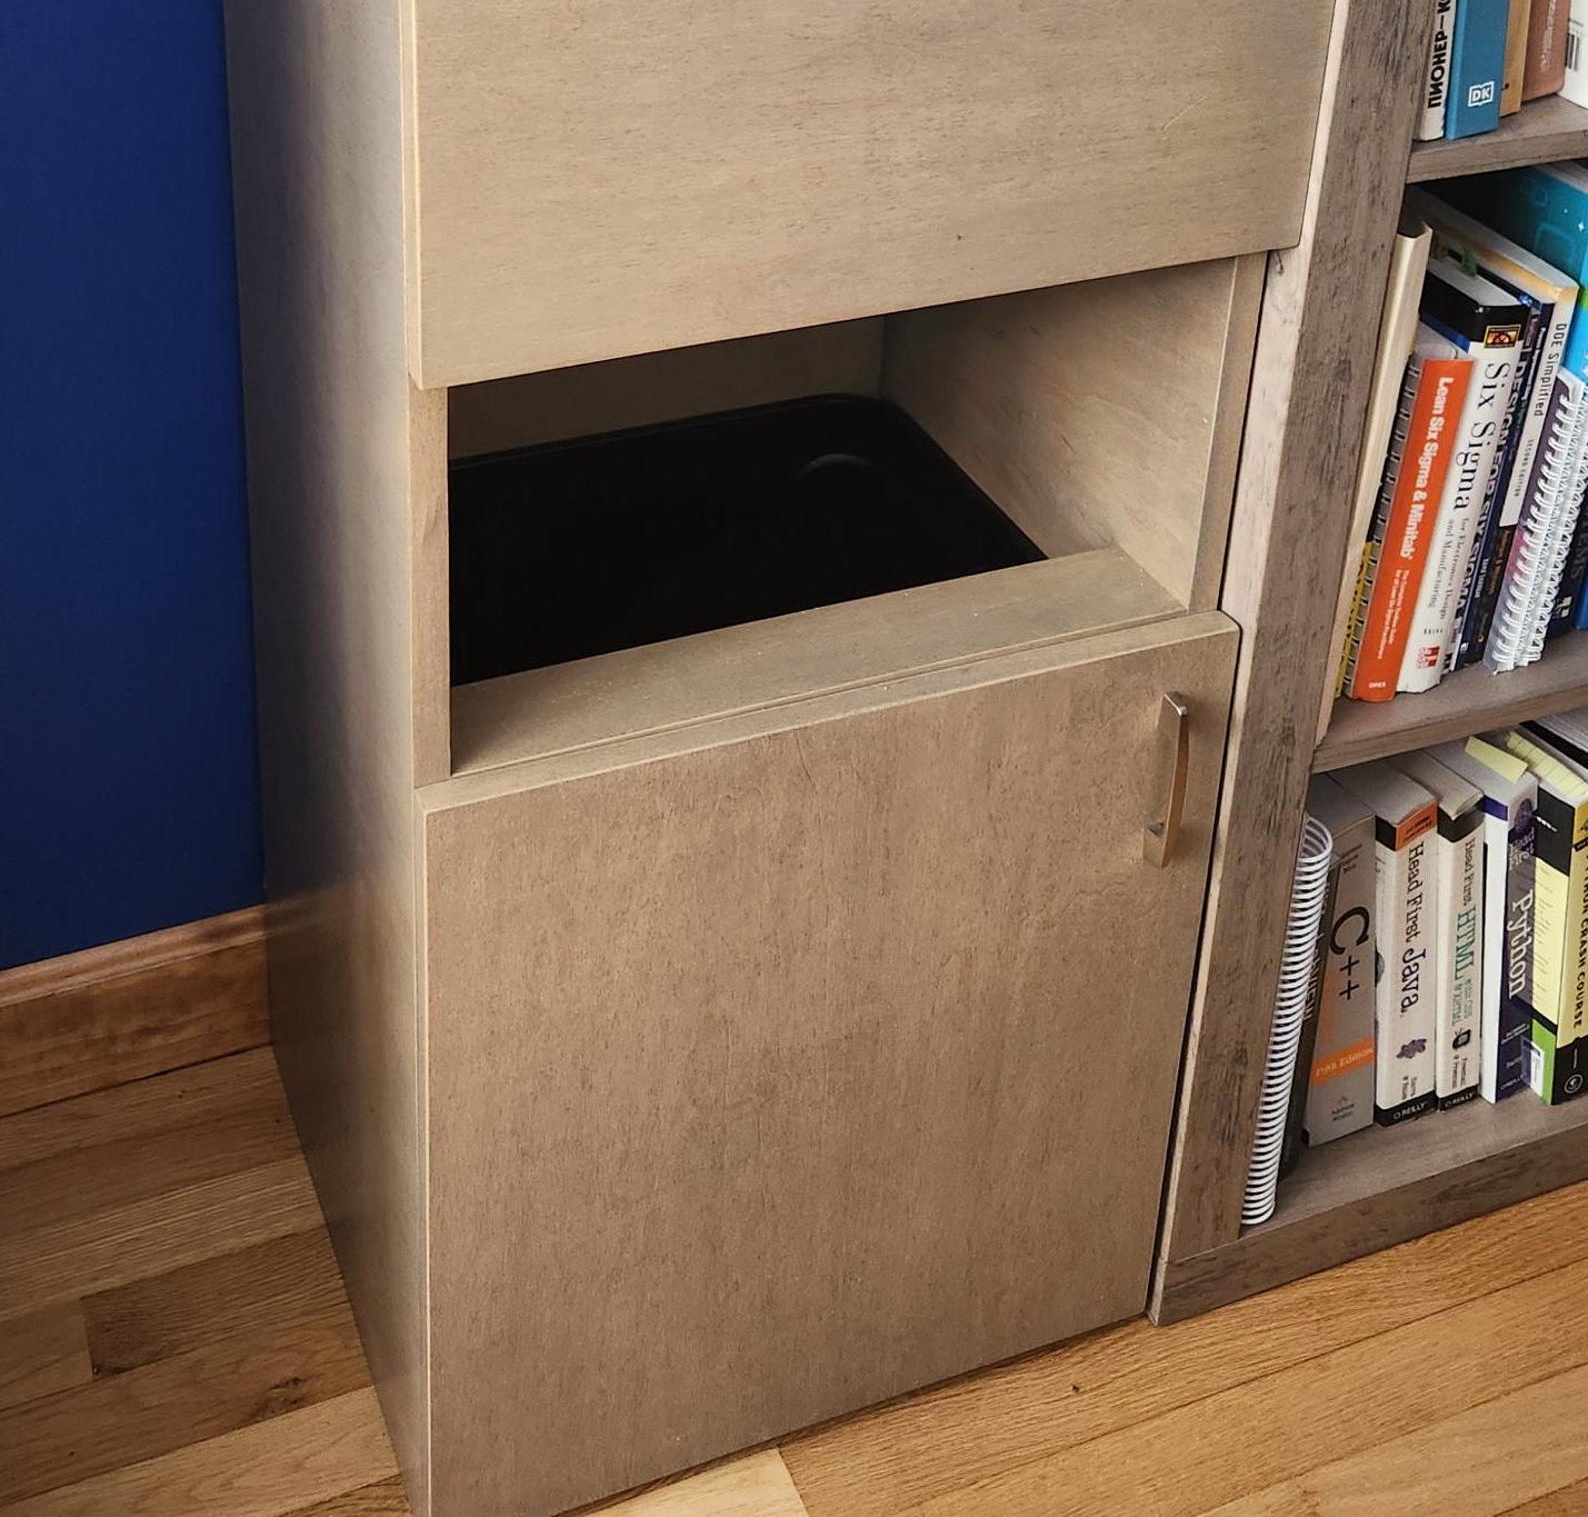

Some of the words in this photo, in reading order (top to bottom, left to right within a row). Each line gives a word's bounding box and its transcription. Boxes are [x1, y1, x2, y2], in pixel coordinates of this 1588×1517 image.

[1471, 86, 1491, 102] DK
[1551, 324, 1567, 348] DOE
[1431, 376, 1455, 415] Lean
[1477, 363, 1511, 410] Six
[1534, 352, 1559, 417] Simplified
[1426, 416, 1446, 440] Six
[1414, 440, 1440, 488] Sigma
[1453, 422, 1497, 510] Sigma
[1412, 489, 1426, 502] &
[1407, 841, 1424, 894] Head
[1464, 838, 1475, 876] Head
[1463, 876, 1475, 906] First
[1405, 892, 1423, 943] First
[1329, 906, 1370, 1000] C++
[1455, 906, 1476, 980] HTML
[1506, 889, 1533, 999] Python
[1573, 971, 1586, 1029] COURSE
